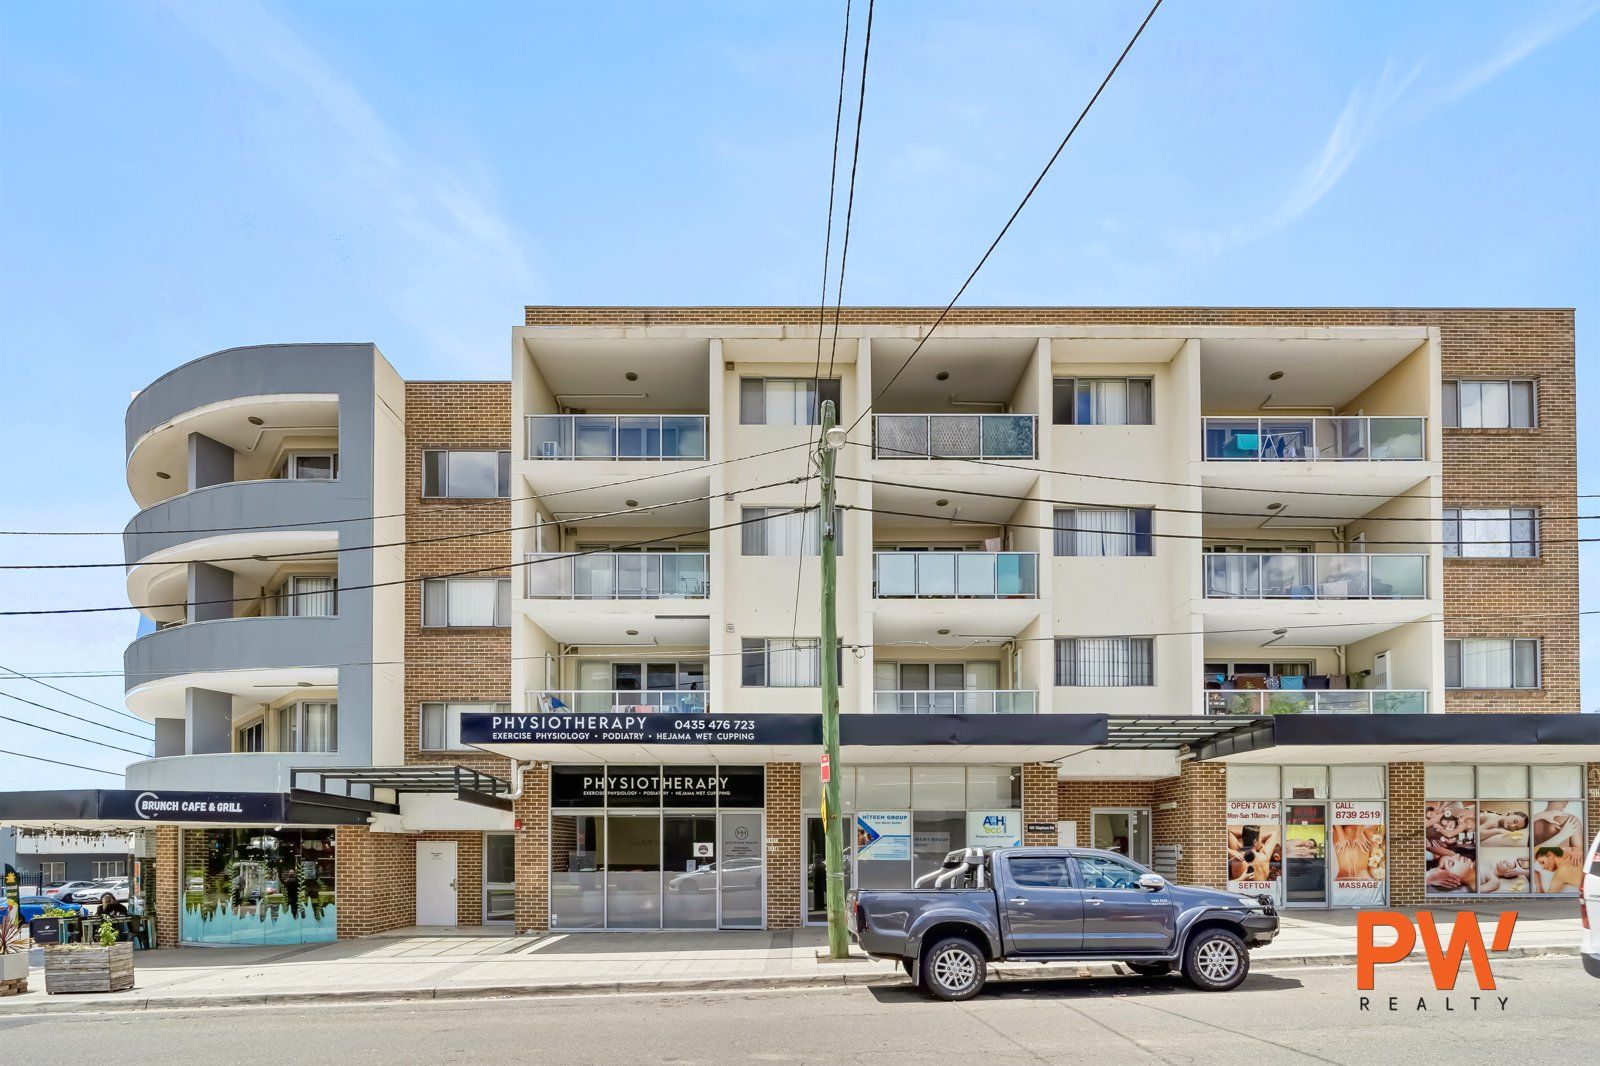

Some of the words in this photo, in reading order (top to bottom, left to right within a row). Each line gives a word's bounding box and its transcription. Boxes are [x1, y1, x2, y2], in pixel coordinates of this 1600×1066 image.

[492, 716, 647, 729] PHYSIOTHERAPY
[674, 720, 706, 730] 0435
[708, 720, 731, 730] 476
[734, 720, 755, 730] 723
[492, 732, 532, 740] EXERCISE
[535, 732, 590, 740] PHYSIOLOGY
[602, 732, 644, 740] PODIATRY
[656, 732, 692, 740] HEJAMA
[695, 732, 713, 740] WET
[716, 732, 755, 740] CUPPING
[583, 777, 729, 789] PHYSIOTHERAPY
[141, 800, 179, 811] BRUNCH
[181, 801, 207, 812] CAFE
[208, 802, 216, 812] &
[216, 802, 243, 813] GRILL
[1230, 802, 1251, 810] OPEN
[1252, 802, 1256, 810] 7
[1257, 802, 1277, 810] DAYS
[1335, 802, 1355, 810] CALL:
[1335, 811, 1357, 819] 8739
[1359, 811, 1381, 819] 2519
[1238, 882, 1271, 890] SEFTON
